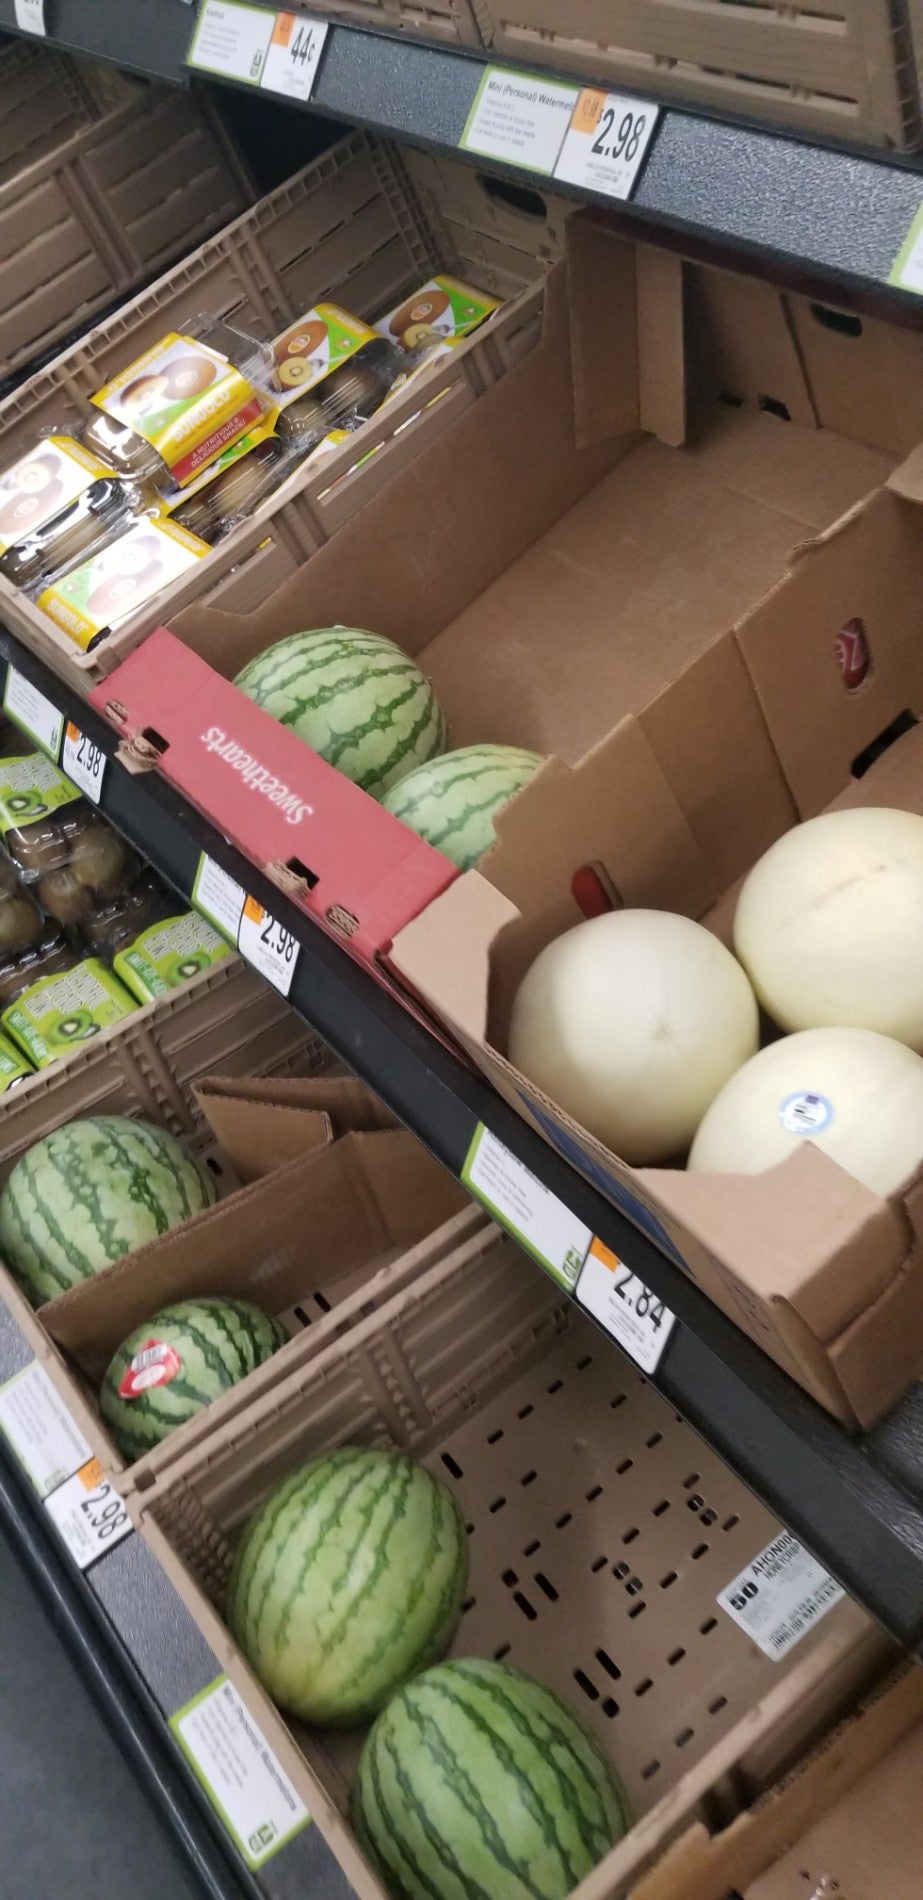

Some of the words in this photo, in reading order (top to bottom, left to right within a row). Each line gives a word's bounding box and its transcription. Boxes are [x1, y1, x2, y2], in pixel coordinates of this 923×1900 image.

[488, 80, 502, 95] Mini
[503, 83, 538, 103] (Personal)
[190, 439, 223, 467] DELICIOUS
[222, 418, 247, 443] SNACK!
[197, 423, 235, 456] NUTRITIOUS
[77, 735, 101, 777] 2.98
[200, 727, 314, 825] Sweethearts
[261, 912, 296, 962] 2.98
[614, 1272, 665, 1332] 2.84
[81, 1484, 128, 1538] 2.98
[730, 1582, 758, 1610] 50
